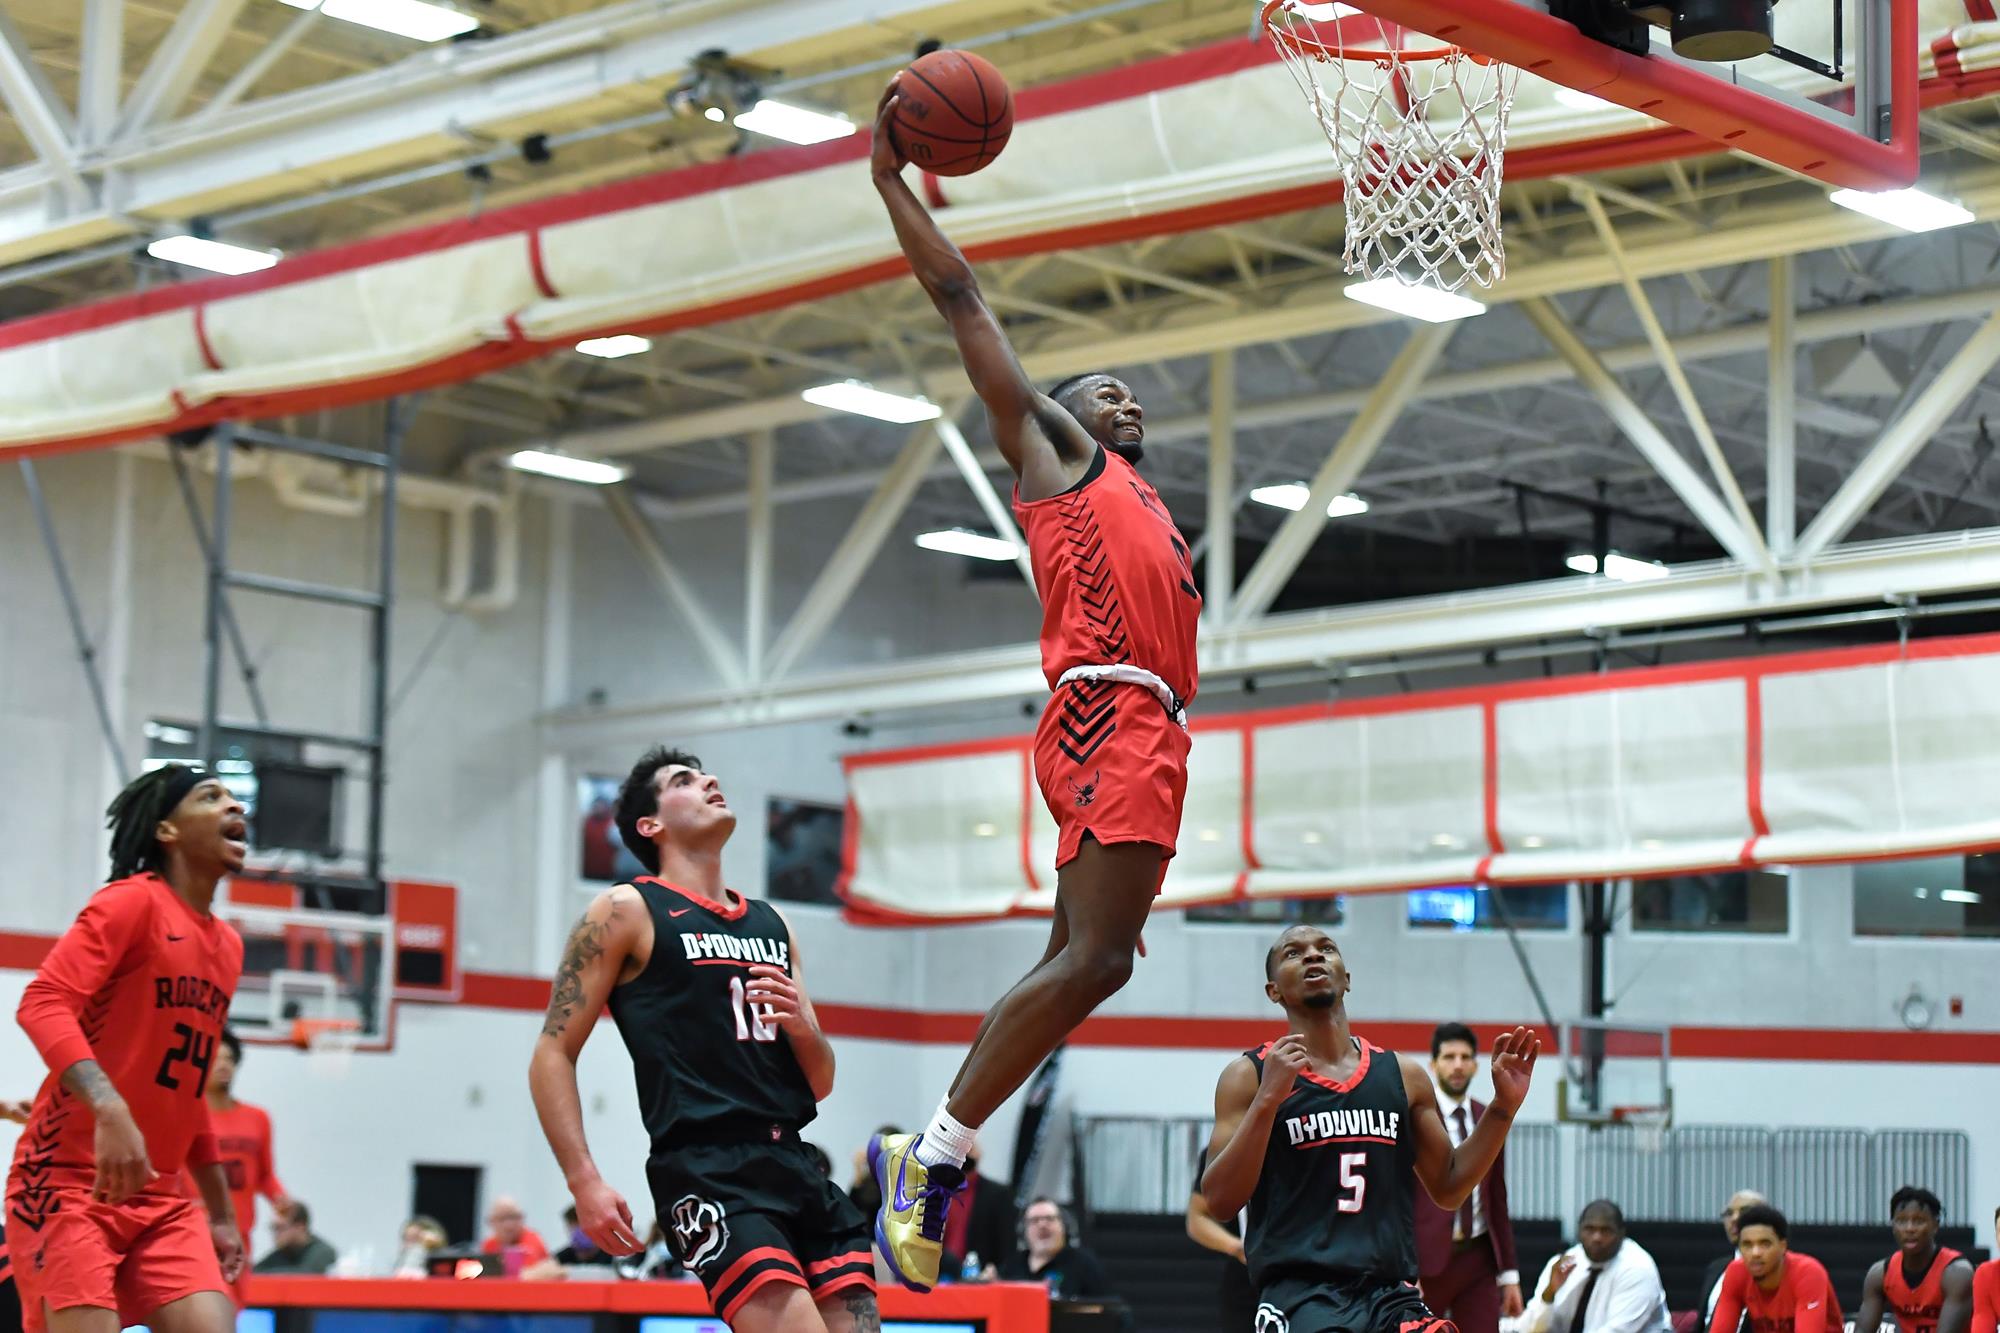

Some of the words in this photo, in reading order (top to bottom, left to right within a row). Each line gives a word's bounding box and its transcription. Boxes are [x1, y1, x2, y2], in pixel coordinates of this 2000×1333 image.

[680, 933, 788, 970] D'YOUVILLE
[155, 1022, 214, 1099] 24
[1285, 1109, 1400, 1146] D'YOUVILLE
[1337, 1152, 1367, 1213] 5
